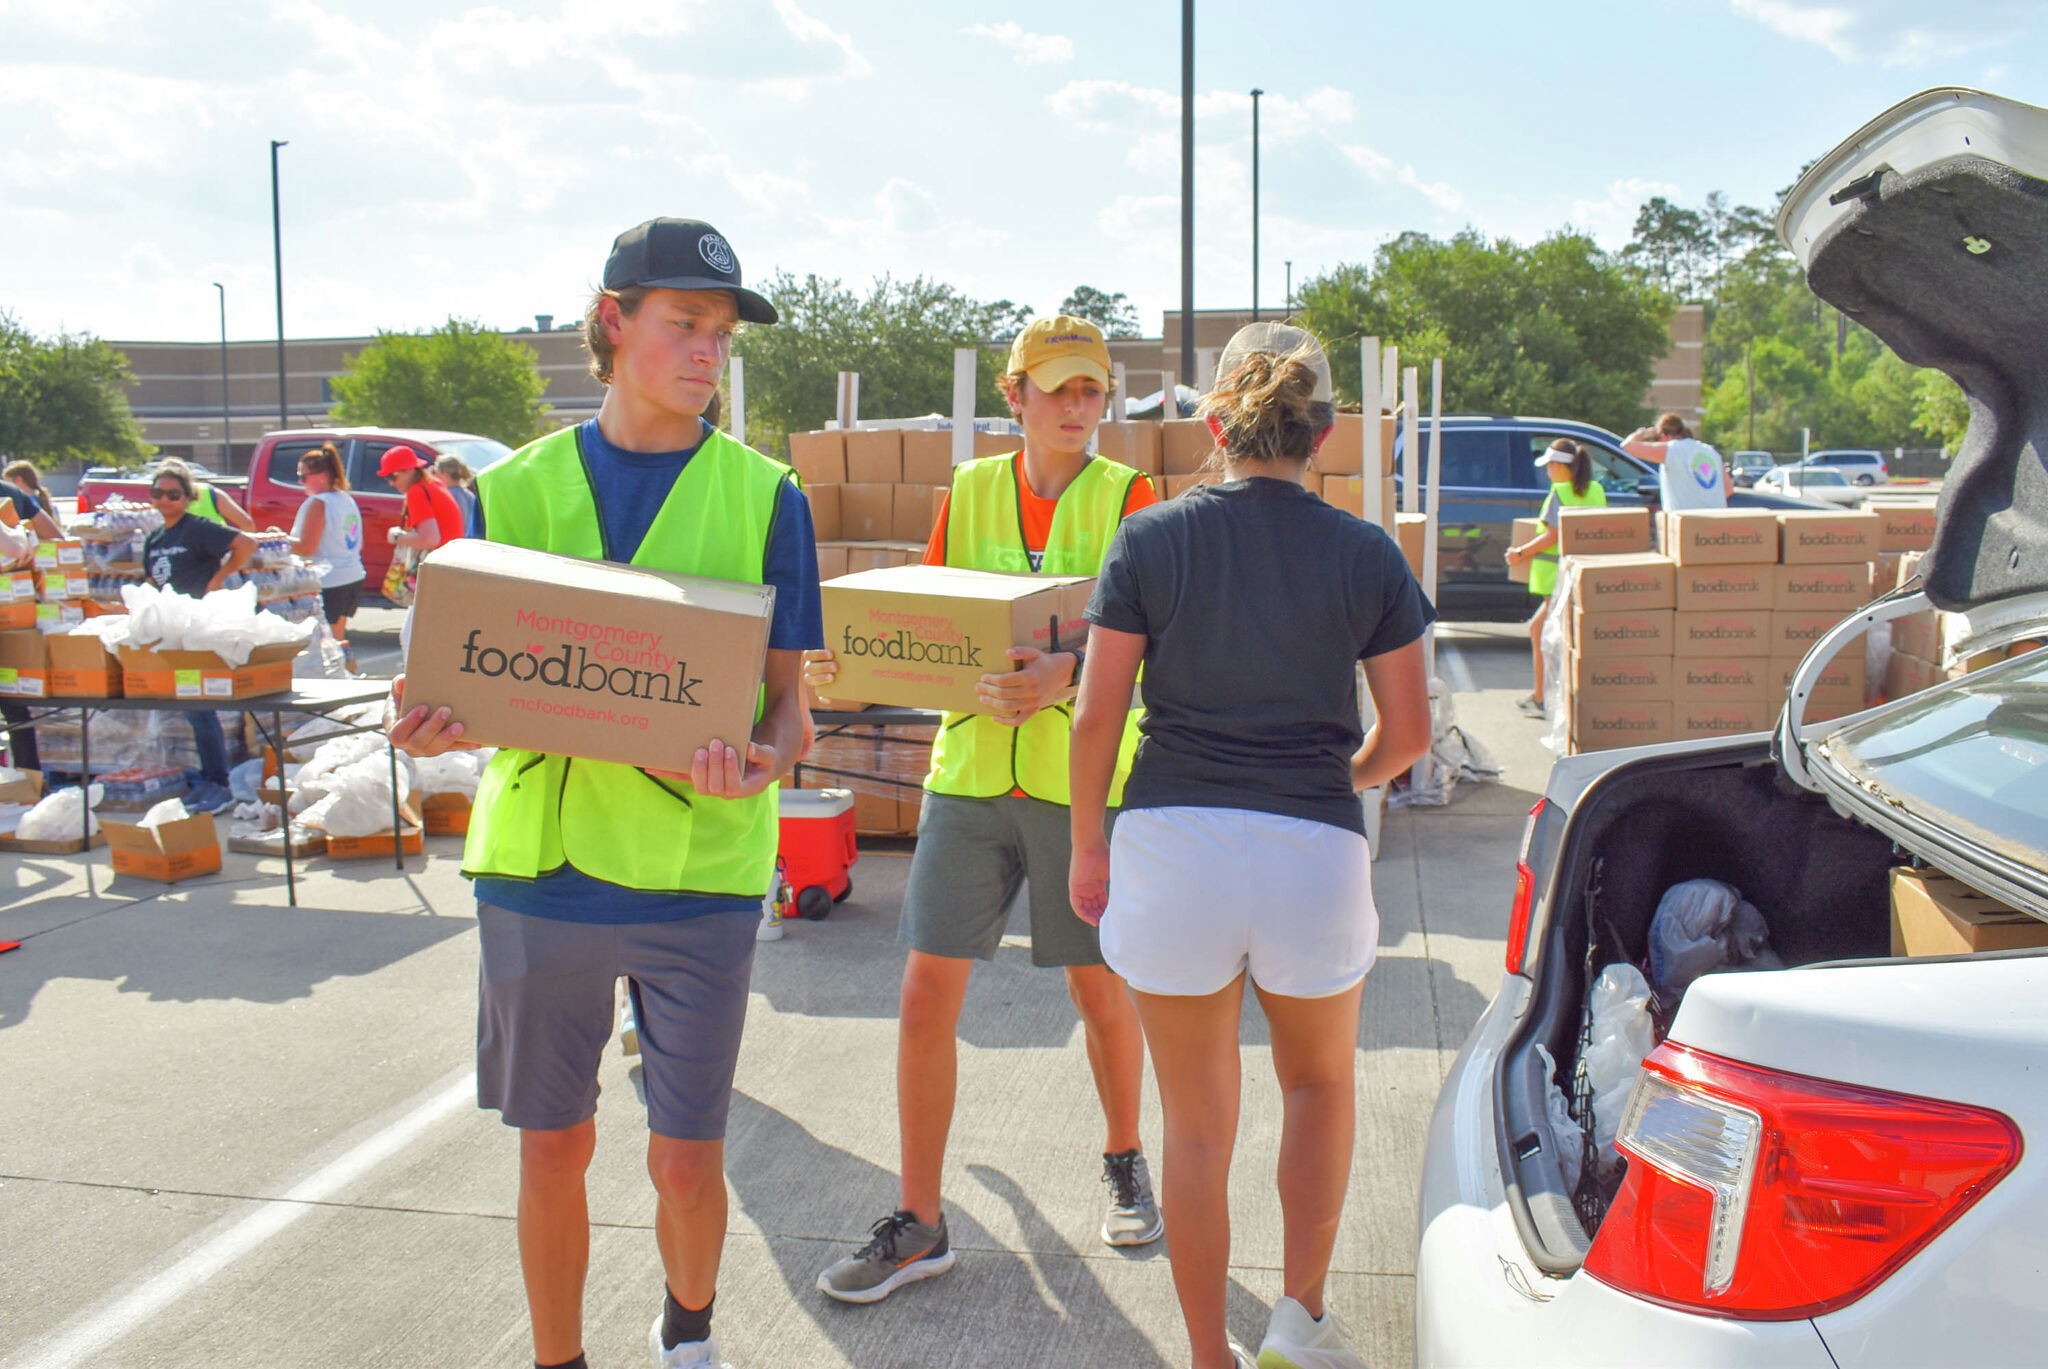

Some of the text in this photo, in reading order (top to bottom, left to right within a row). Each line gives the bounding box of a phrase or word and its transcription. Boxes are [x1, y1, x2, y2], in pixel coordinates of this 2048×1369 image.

[1575, 527, 1637, 541] foodbank
[1694, 532, 1763, 546] foodbank
[1800, 532, 1866, 546] foodbank
[1595, 579, 1662, 595] foodbank
[1692, 579, 1759, 594] foodbank
[1787, 580, 1855, 594] foodbank
[869, 608, 953, 629] Montgomery
[516, 608, 663, 649] Montgomery
[1593, 626, 1660, 641] foodbank
[1689, 626, 1757, 640] foodbank
[843, 625, 983, 668] foodbank
[594, 641, 677, 673] County
[460, 630, 702, 706] foodbank
[1591, 672, 1658, 687] foodbank
[1686, 671, 1754, 686] foodbank
[510, 696, 649, 731] mcfoodbank.org
